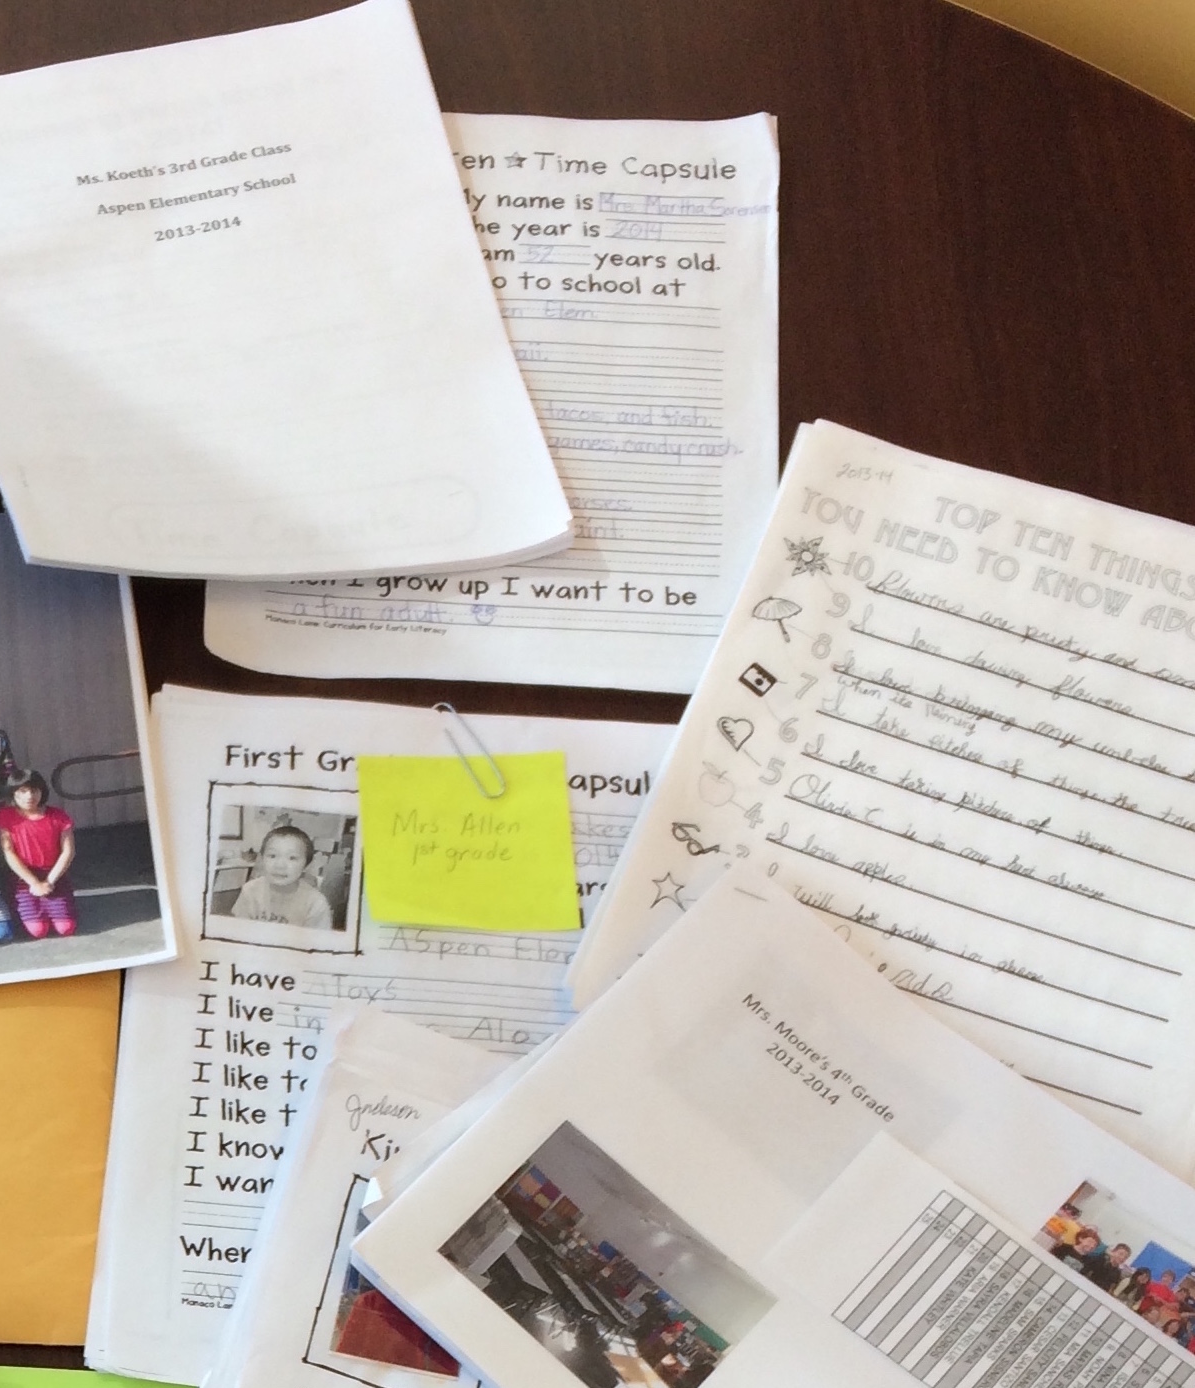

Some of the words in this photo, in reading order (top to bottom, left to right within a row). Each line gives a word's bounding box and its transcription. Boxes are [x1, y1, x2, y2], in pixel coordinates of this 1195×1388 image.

[105, 164, 166, 183] Koeth's
[167, 157, 198, 174] 3rd
[199, 149, 248, 170] Grade
[250, 142, 293, 161] Class
[533, 150, 608, 175] Time
[621, 155, 737, 184] Capsule
[96, 199, 146, 219] Aspen
[148, 182, 241, 211] Elementary
[243, 172, 297, 194] School
[497, 192, 565, 211] name
[575, 193, 594, 211] is
[153, 216, 242, 242] 2013-2014
[512, 221, 573, 241] year
[582, 222, 601, 239] is
[593, 249, 667, 271] years
[677, 253, 721, 272] old.
[518, 271, 552, 290] to
[561, 273, 641, 295] school
[652, 278, 687, 298] at
[935, 495, 1001, 535] TOP
[1013, 519, 1076, 562] TEN
[801, 486, 865, 536] YOU
[872, 518, 959, 566] NEED
[976, 545, 1021, 582] TO
[1031, 565, 1134, 618] KNOW
[374, 575, 449, 602] grow
[456, 577, 489, 600] up
[499, 575, 520, 597] I
[530, 579, 608, 603] want
[617, 579, 654, 604] to
[665, 583, 698, 607] be
[224, 743, 304, 772] First
[461, 811, 521, 837] Allen
[412, 840, 438, 866] 1st
[445, 840, 514, 874] grade
[199, 960, 220, 981] I
[229, 963, 297, 992] have
[742, 993, 771, 1025] Mrs.
[774, 1020, 830, 1071] Moore's
[831, 1067, 853, 1085] 4th
[850, 1084, 895, 1123] Grade
[765, 1042, 841, 1106] 2013-2014
